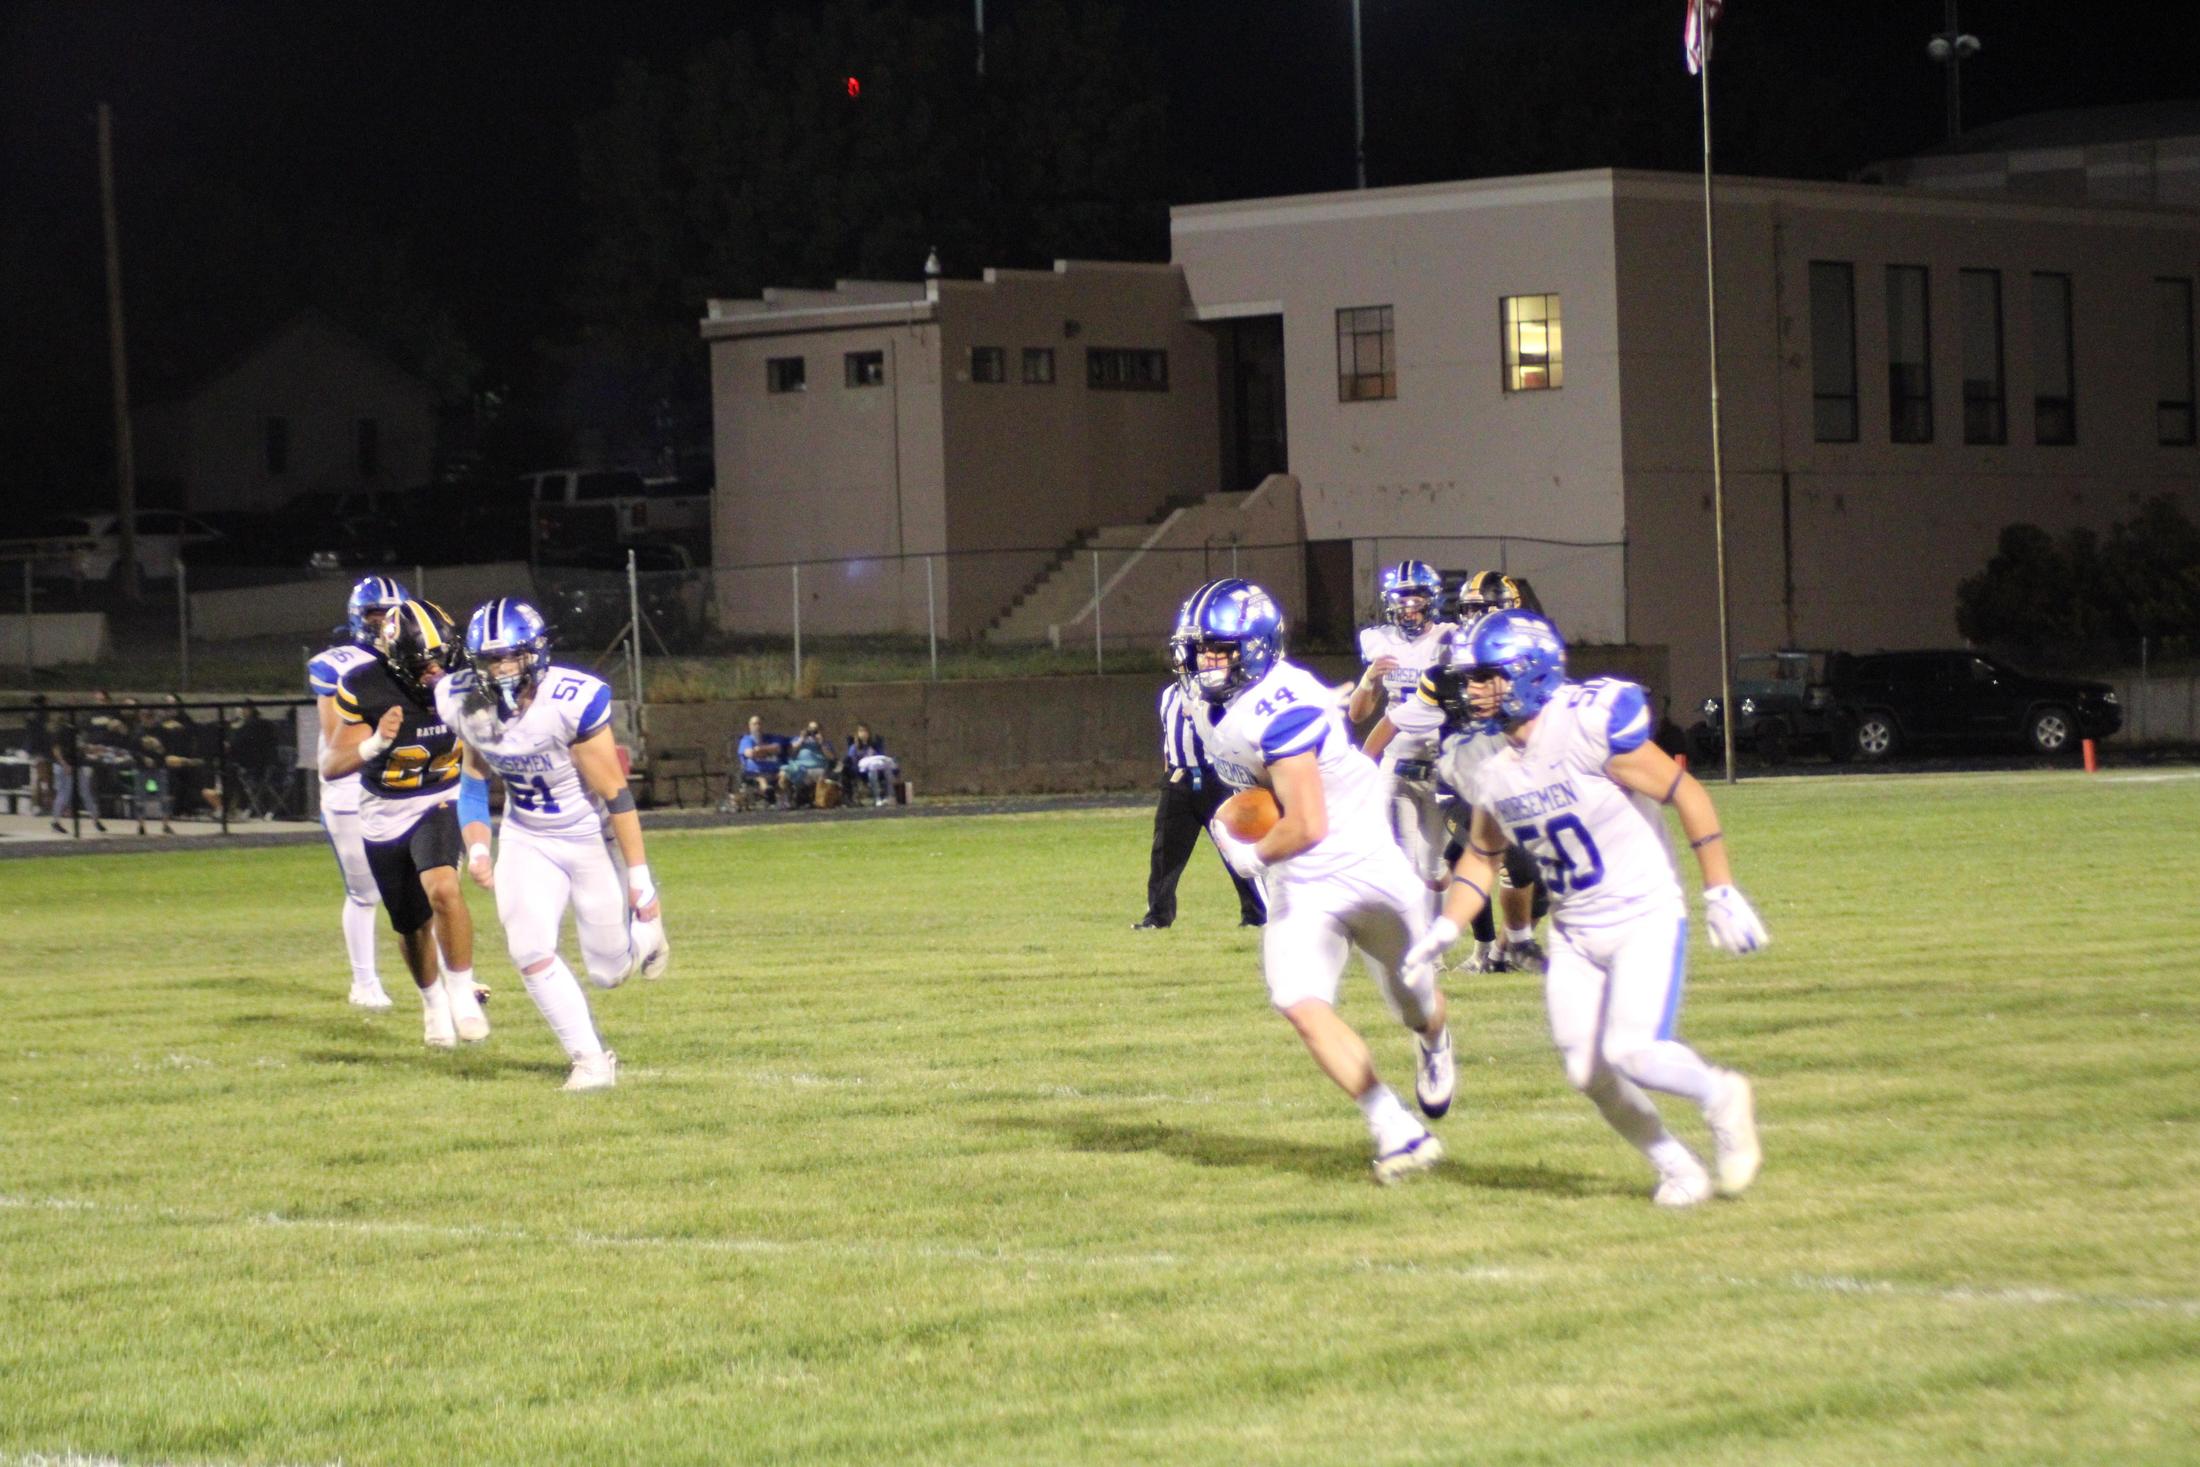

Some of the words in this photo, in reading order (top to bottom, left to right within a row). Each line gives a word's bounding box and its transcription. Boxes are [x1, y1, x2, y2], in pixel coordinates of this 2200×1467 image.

[552, 677, 587, 702] 51
[1254, 686, 1298, 717] 44
[416, 724, 448, 738] RATON
[484, 751, 554, 773] SEMEN
[502, 773, 561, 814] 51
[1512, 811, 1605, 895] 50
